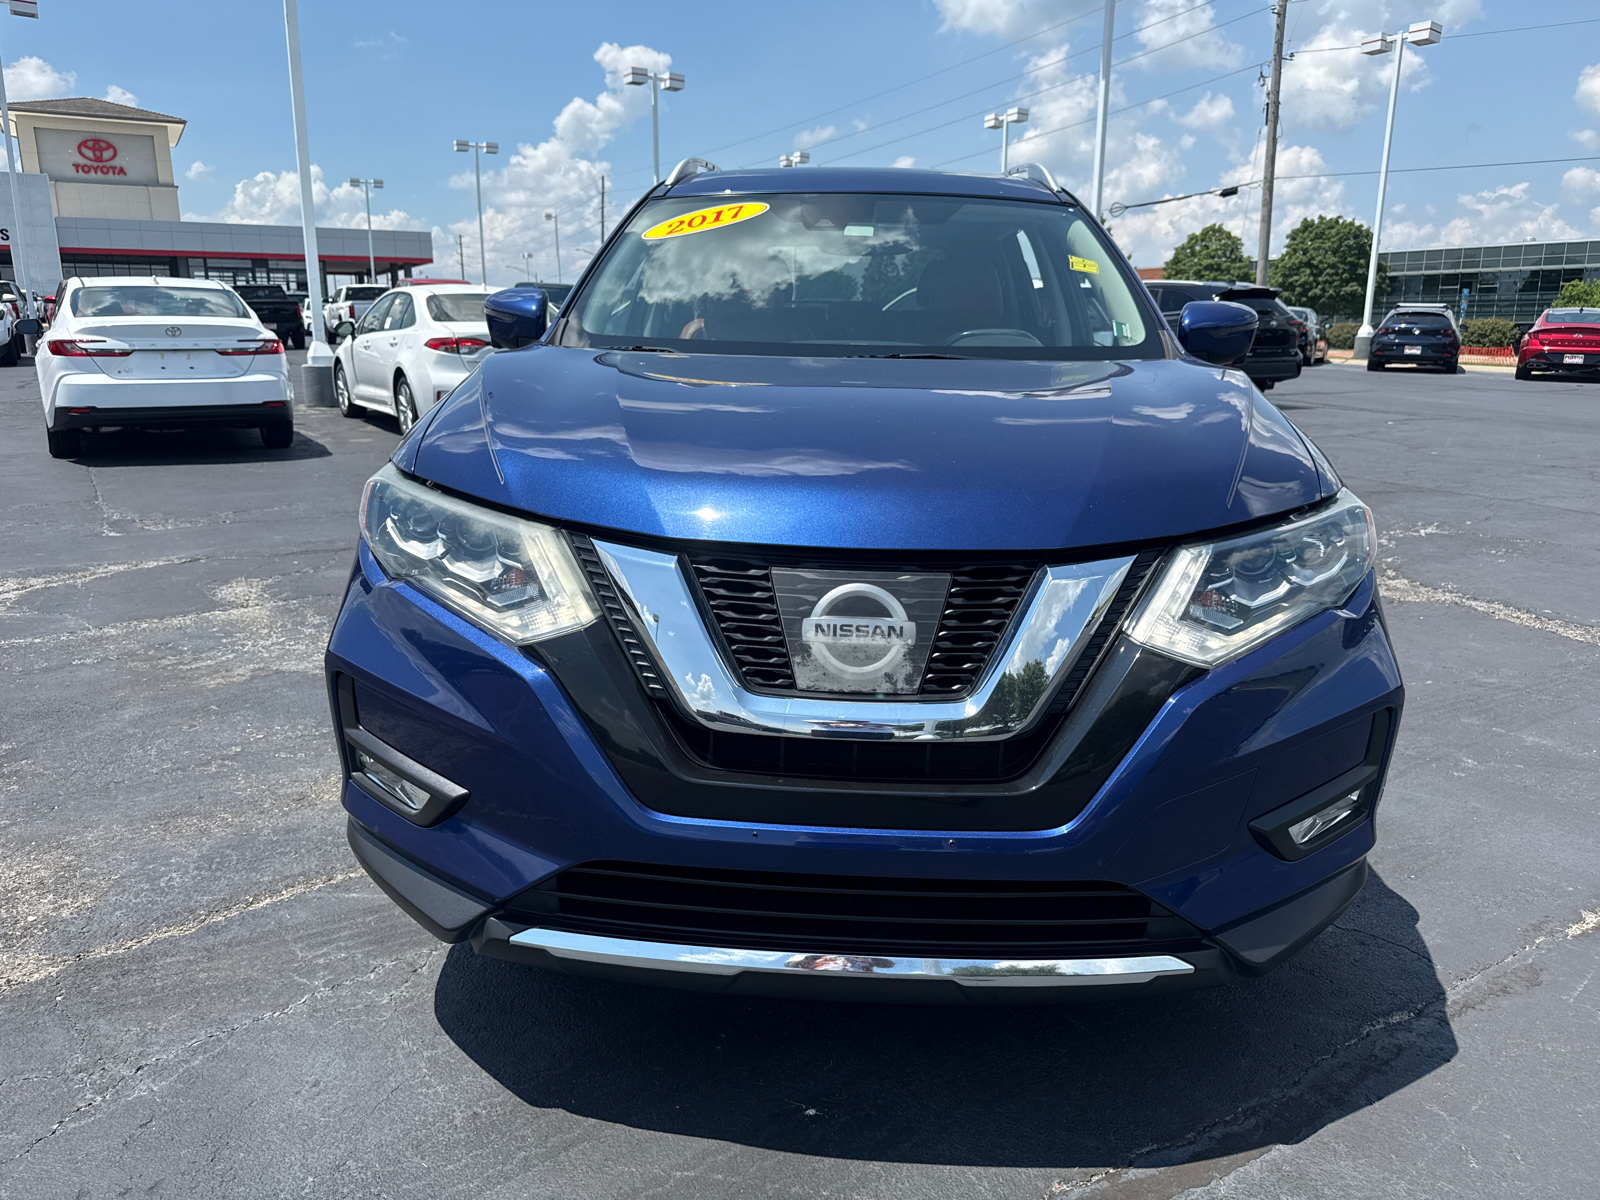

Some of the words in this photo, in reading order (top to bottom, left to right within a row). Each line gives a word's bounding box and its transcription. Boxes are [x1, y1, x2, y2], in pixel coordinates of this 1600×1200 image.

[72, 163, 127, 176] TOYOTA
[665, 205, 744, 236] 2017
[814, 622, 904, 639] NISSAN
